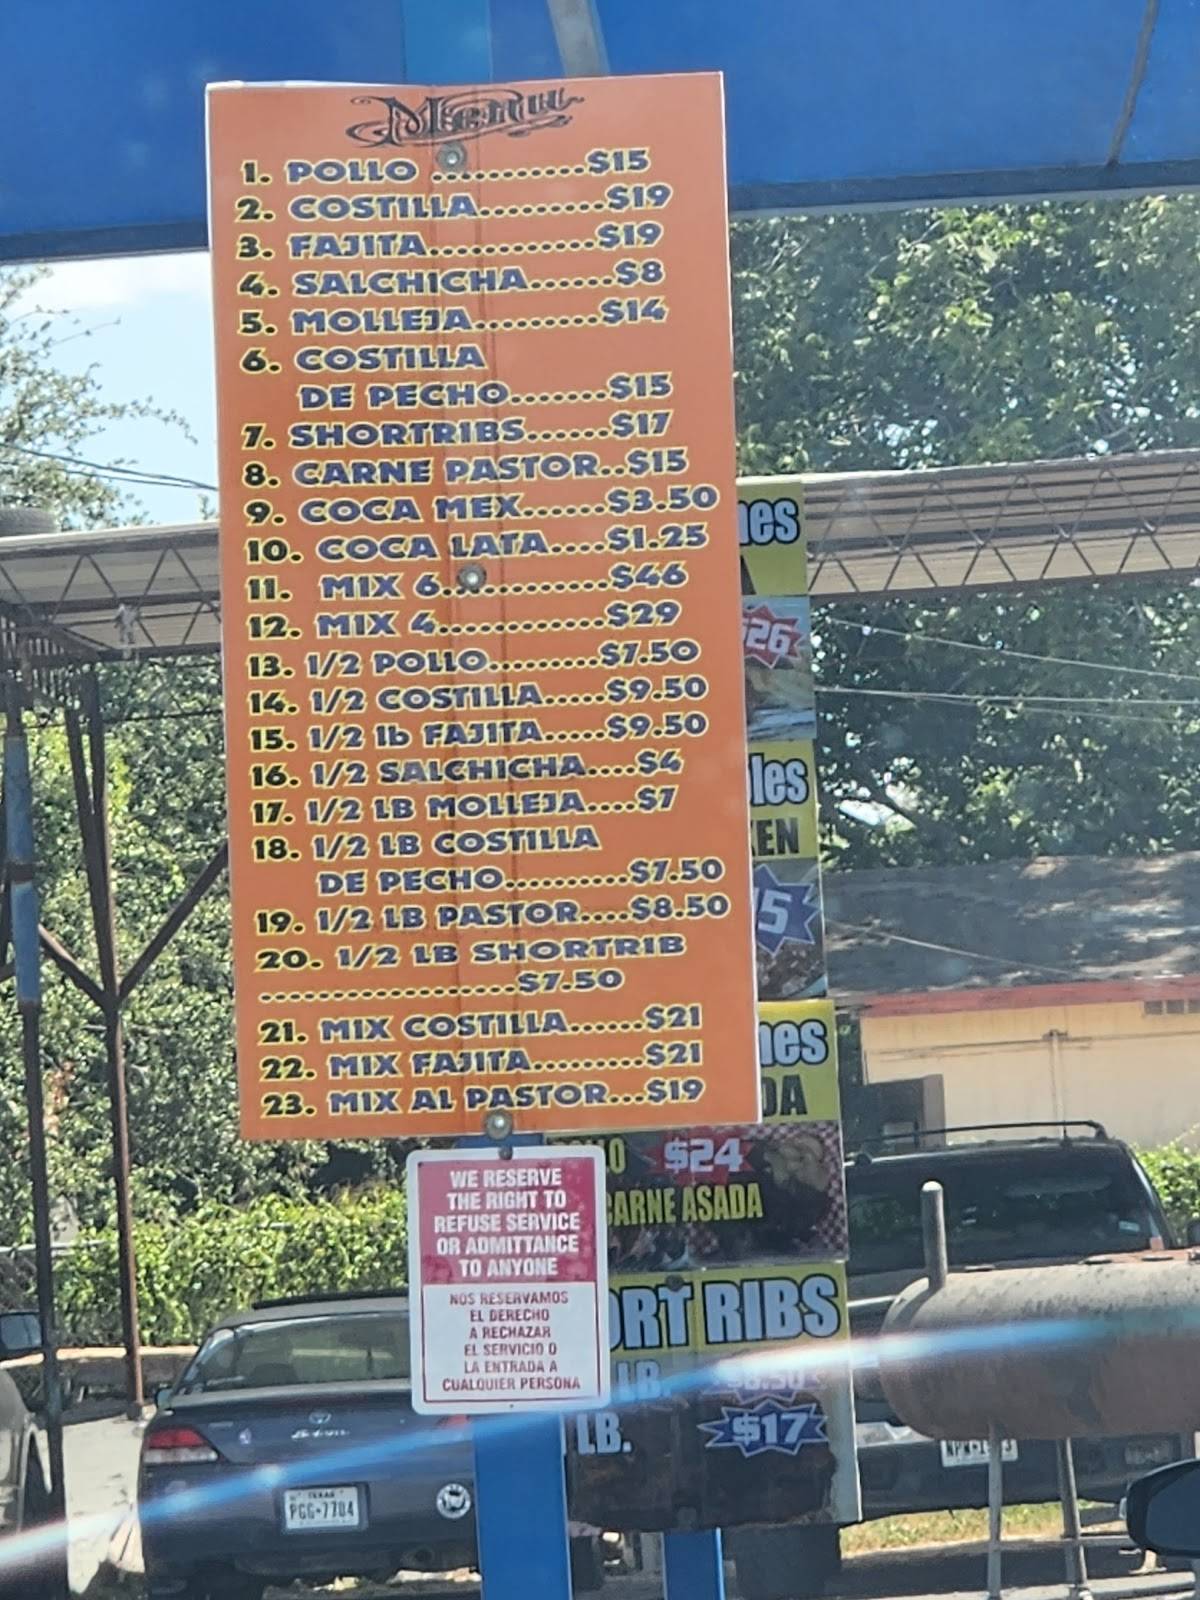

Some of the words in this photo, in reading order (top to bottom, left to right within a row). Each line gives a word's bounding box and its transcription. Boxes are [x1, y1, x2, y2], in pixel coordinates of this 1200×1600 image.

[346, 88, 583, 147] Menu
[242, 161, 271, 184] 1.
[586, 148, 650, 175] $15
[236, 197, 275, 221] 2.
[607, 183, 672, 212] $19
[237, 234, 274, 259] 3.
[598, 221, 663, 249] $19
[238, 273, 279, 297] 4.
[615, 259, 664, 287] $8
[238, 310, 277, 335] 5.
[601, 297, 668, 325] $14
[240, 348, 281, 373] 6.
[297, 384, 354, 410] DE
[608, 373, 672, 401] $15
[242, 424, 275, 449] 7.
[611, 410, 673, 439] $17
[243, 462, 280, 487] 8.
[293, 458, 433, 487] CARNE
[626, 448, 688, 477] $15
[244, 500, 286, 525] 9.
[299, 497, 423, 524] COCA
[606, 485, 719, 515] $3.50
[245, 538, 303, 564] 10.
[316, 535, 440, 562] COCA
[606, 523, 708, 553] $1.25
[246, 576, 292, 602] 11.
[319, 574, 404, 600] MIX
[609, 562, 688, 591] $46
[247, 614, 301, 640] 12.
[314, 612, 400, 638] MIX
[606, 600, 681, 629] $29
[247, 654, 294, 679] 13.
[305, 651, 362, 678] 1/2
[599, 639, 700, 668] $7.50
[248, 691, 299, 715] 14.
[310, 687, 367, 715] 1/2
[606, 675, 708, 704] $9.50
[249, 727, 297, 752] 15.
[308, 725, 365, 752] 1/2
[374, 724, 411, 748] lb
[606, 712, 708, 741] $9.50
[250, 764, 300, 788] 16.
[311, 760, 368, 788] 1/2
[639, 749, 683, 776] $4
[251, 800, 295, 825] 17.
[305, 799, 363, 825] 1/2
[372, 797, 415, 821] LB
[637, 786, 678, 812] $7
[252, 837, 301, 861] 18.
[312, 835, 369, 861] 1/2
[378, 833, 422, 857] LB
[316, 870, 367, 896] DE
[629, 857, 724, 886] $7.50
[255, 910, 305, 935] 19.
[316, 907, 373, 934] 1/2
[382, 905, 426, 930] LB
[630, 893, 730, 922] $8.50
[255, 948, 323, 971] 20.
[336, 945, 400, 969] 1/2
[411, 943, 459, 966] LB
[471, 934, 686, 963] SHORTRIB
[518, 967, 624, 995] $7.50
[258, 1021, 308, 1045] 21.
[319, 1017, 394, 1043] MIX
[644, 1004, 701, 1032] $21
[260, 1057, 316, 1081] 22.
[327, 1053, 402, 1079] MIX
[644, 1041, 702, 1068] $21
[262, 1093, 316, 1117] 23.
[327, 1090, 402, 1115] MIX
[409, 1088, 456, 1112] AL
[645, 1077, 705, 1104] $19
[663, 1137, 744, 1173] $24
[450, 1171, 477, 1188] WE
[484, 1168, 562, 1187] RESERVE
[447, 1192, 480, 1210] THE
[486, 1191, 538, 1210] RIGHT
[543, 1190, 566, 1208] TO
[682, 1182, 763, 1222] ASADA
[434, 1215, 501, 1233] REFUSE
[506, 1212, 580, 1231] SERVICE
[437, 1237, 460, 1255] OR
[465, 1235, 579, 1254] ADMITTANCE
[459, 1259, 482, 1278] TO
[487, 1257, 558, 1276] ANYONE
[450, 1293, 475, 1306] NOS
[480, 1290, 569, 1305] RESERVAMOS
[470, 1310, 484, 1322] EL
[489, 1308, 550, 1321] DERECHO
[702, 1274, 840, 1345] RIBS
[464, 1344, 479, 1356] EL
[483, 1342, 543, 1355] SERVICIO
[548, 1342, 557, 1355] O
[470, 1327, 478, 1340] A
[483, 1325, 551, 1338] RECHAZAR
[442, 1378, 516, 1392] CUALQUIER
[520, 1376, 580, 1390] PERSONA
[464, 1361, 480, 1374] LA
[485, 1360, 544, 1373] ENTRADA
[549, 1359, 558, 1373] A
[732, 1411, 809, 1447] $17
